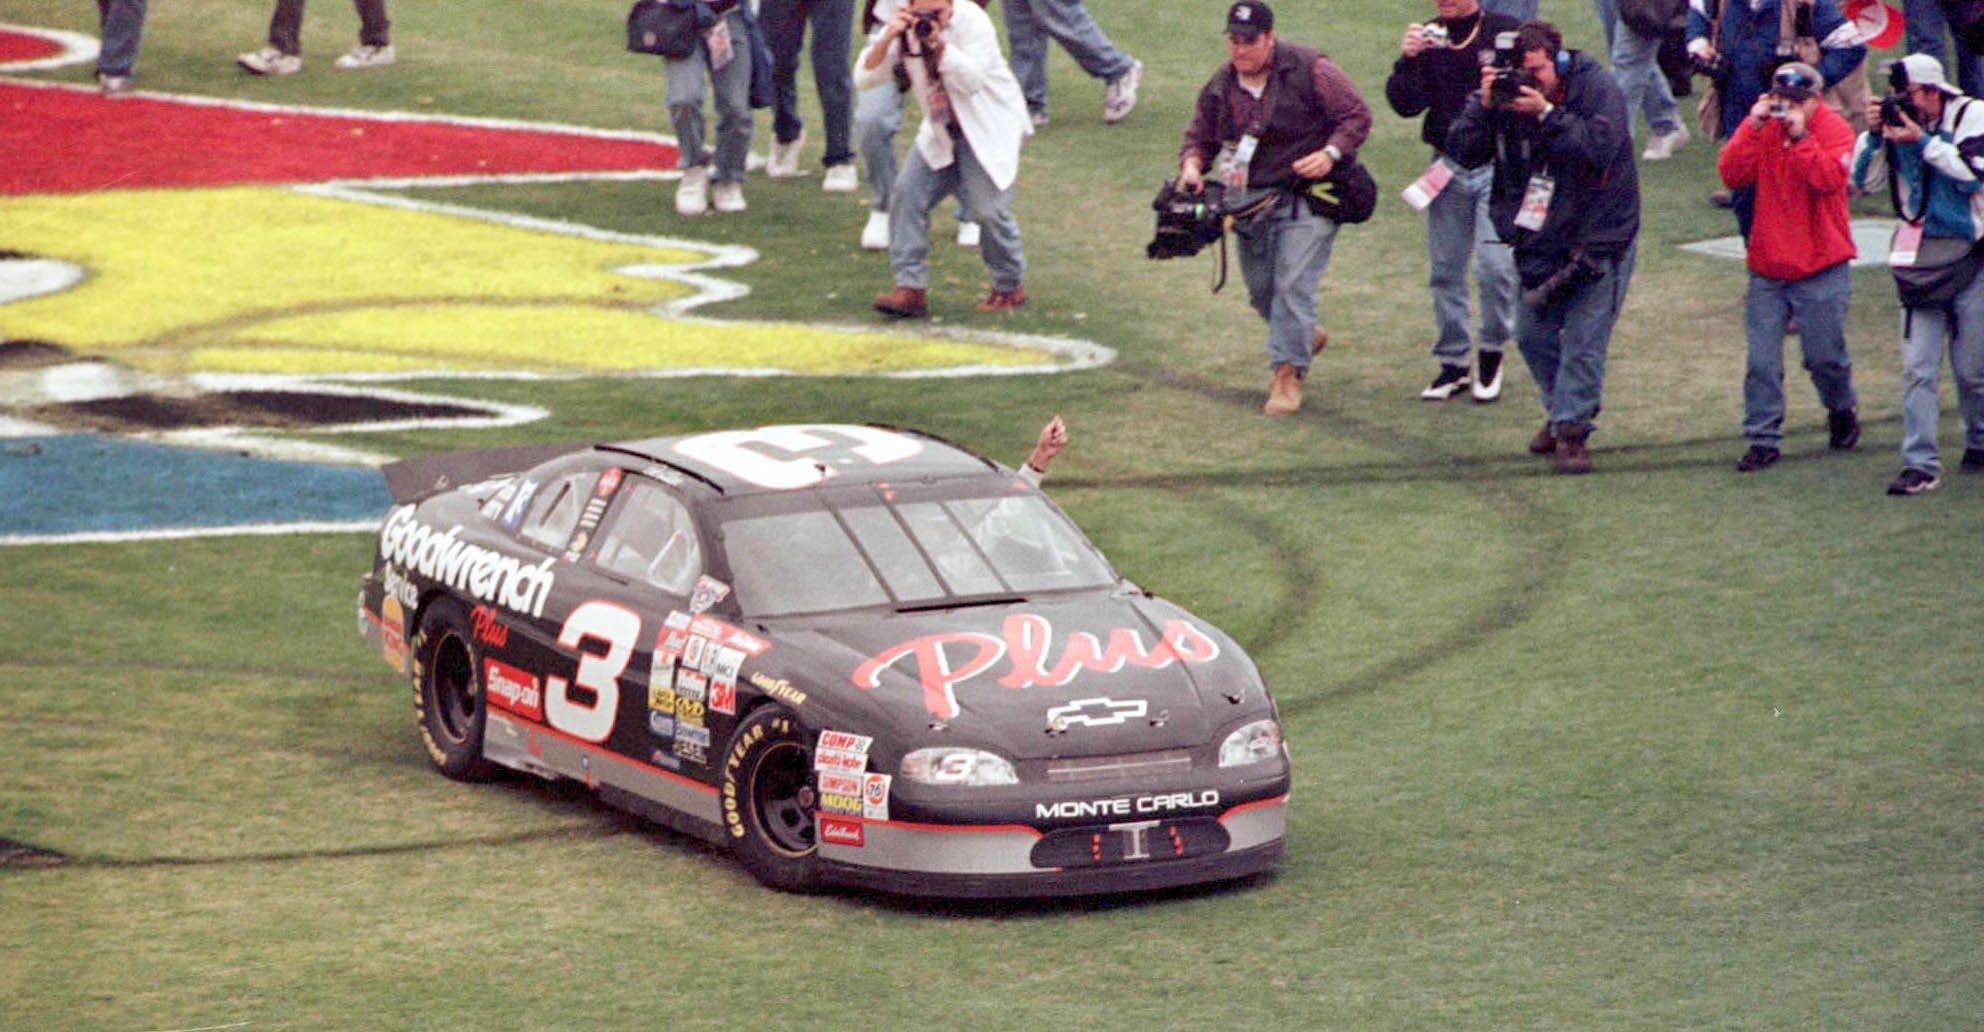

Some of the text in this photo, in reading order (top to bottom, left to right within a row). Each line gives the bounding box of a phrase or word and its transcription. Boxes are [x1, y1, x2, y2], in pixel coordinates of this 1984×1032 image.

[381, 503, 558, 618] Goodwrench
[470, 604, 510, 648] Plus
[488, 666, 541, 708] Snap-on
[545, 599, 642, 744] 3
[851, 613, 1220, 719] Plus
[711, 683, 736, 714] 3M
[822, 732, 857, 748] COMP
[724, 724, 763, 837] GOODYEAR
[935, 753, 978, 784] 3
[822, 793, 863, 811] MOOG
[1036, 790, 1219, 818] MONTE CARLO
